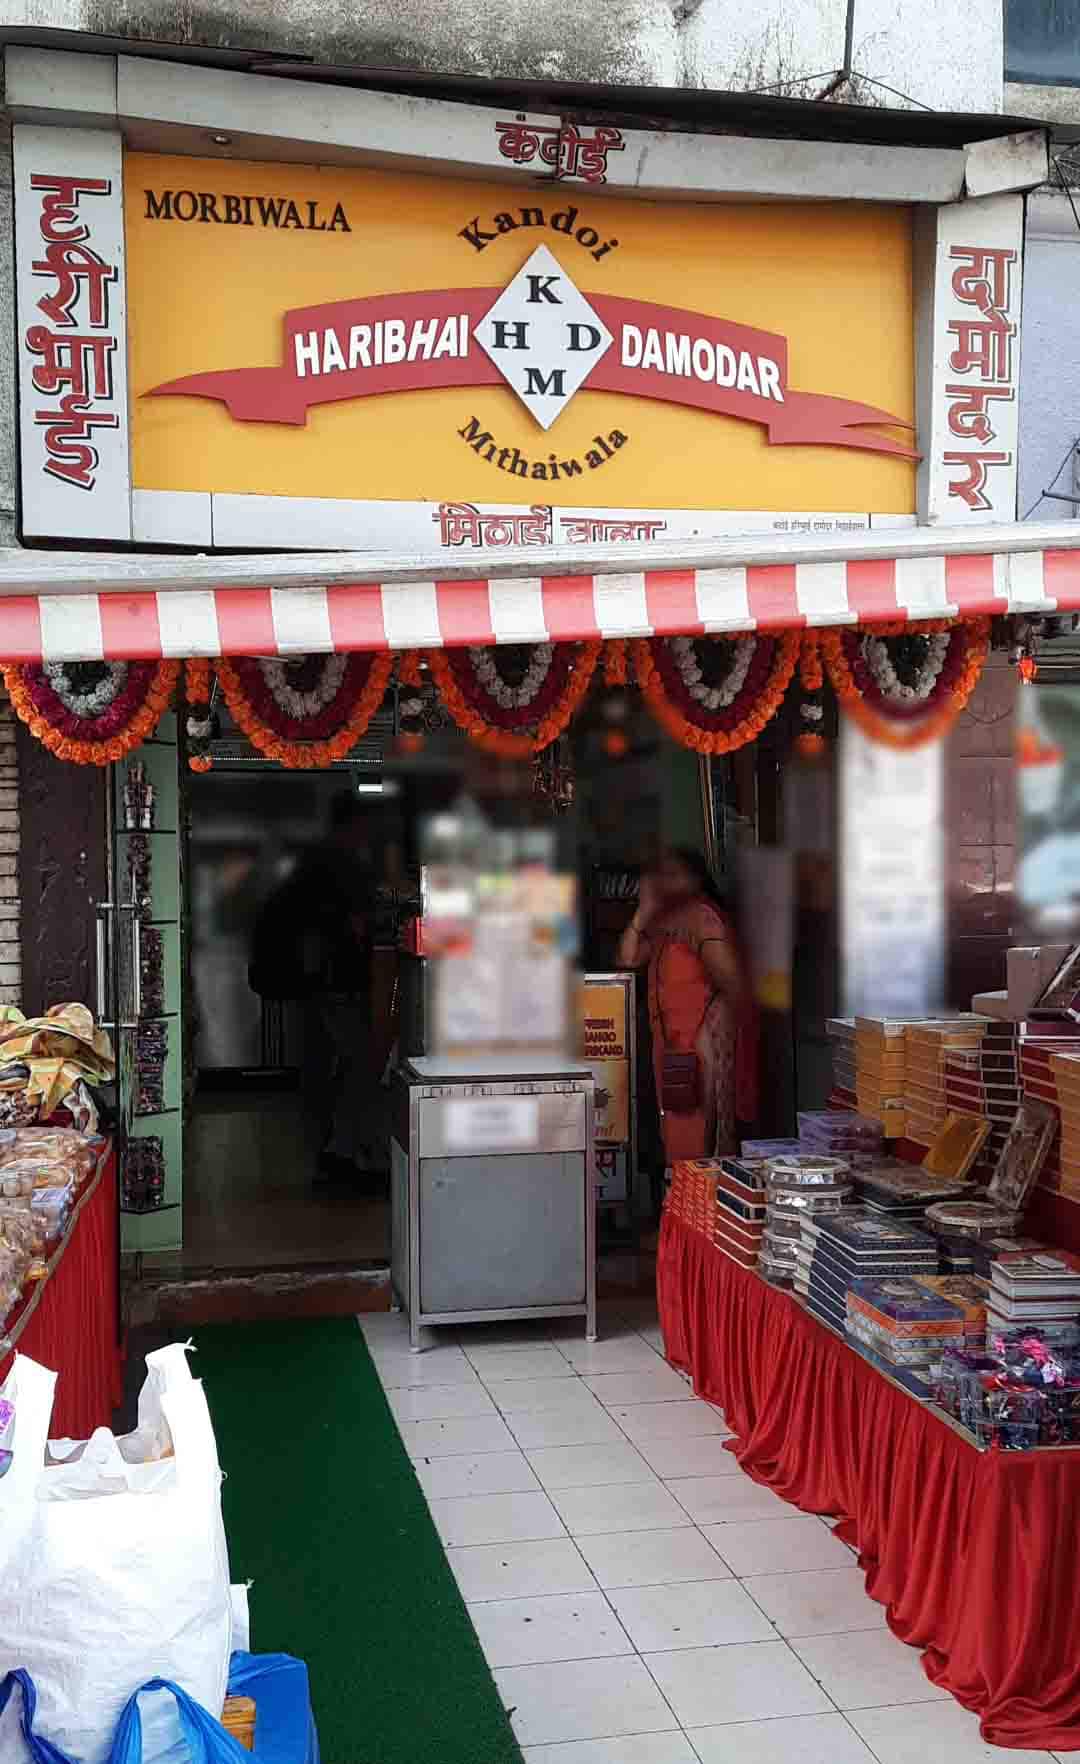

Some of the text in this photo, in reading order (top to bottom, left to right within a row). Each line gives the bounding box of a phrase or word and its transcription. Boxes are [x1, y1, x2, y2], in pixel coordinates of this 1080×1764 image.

[143, 189, 352, 233] MORBIWALA
[457, 206, 619, 262] Kandoi
[526, 275, 563, 304] K
[293, 314, 470, 378] HARIBHAI
[620, 323, 785, 402] DAMODAR
[523, 367, 567, 397] M
[943, 245, 1017, 511] दामोदर
